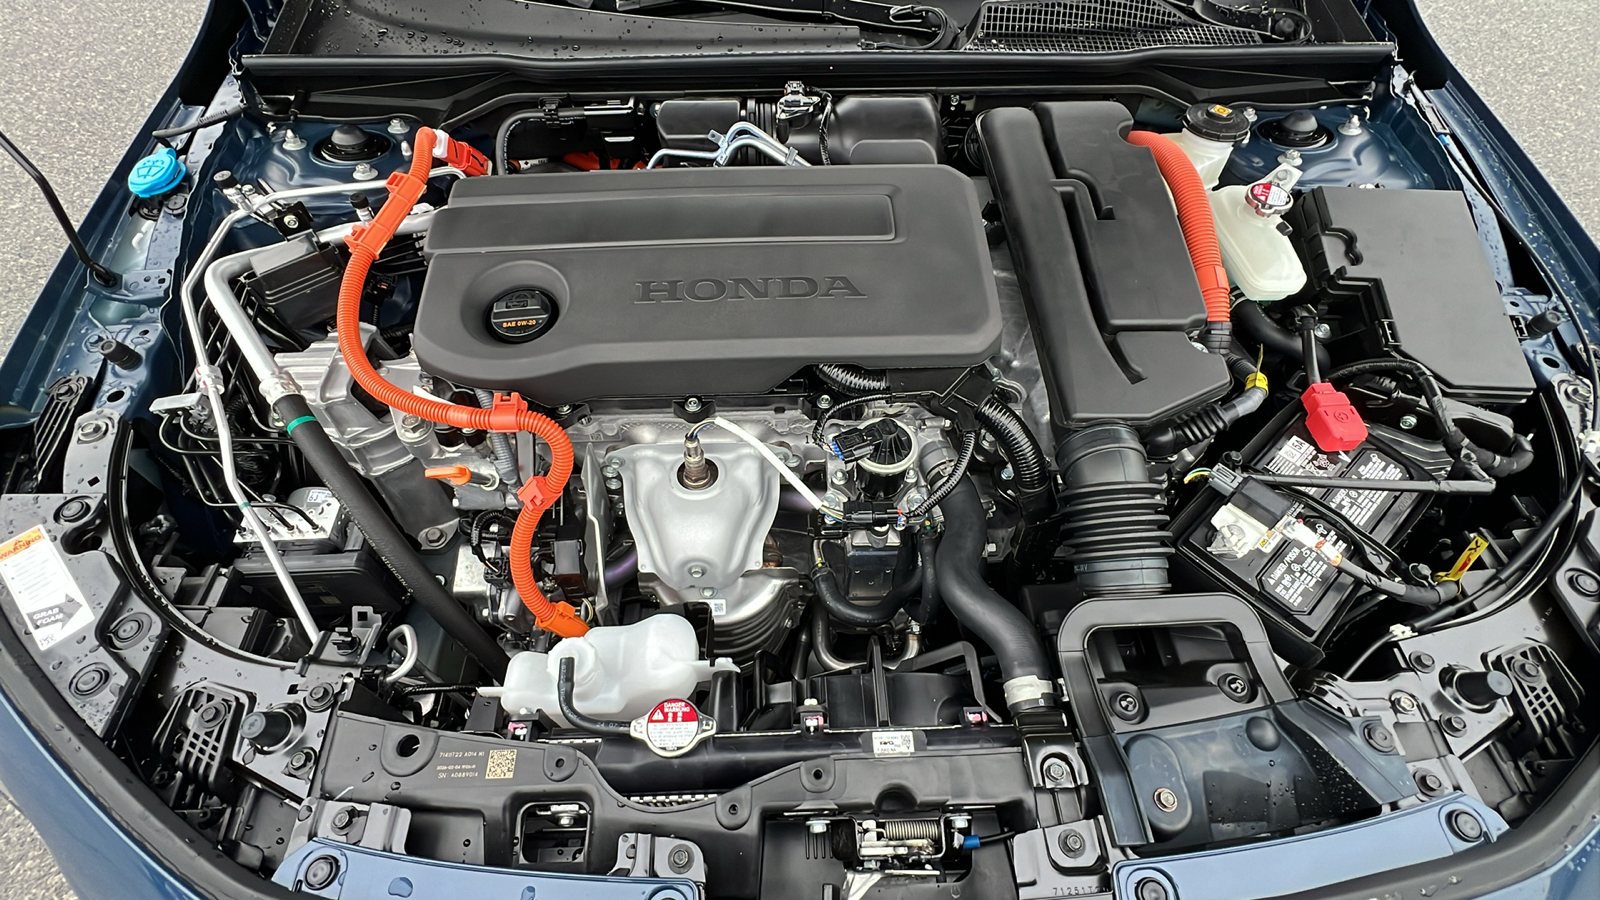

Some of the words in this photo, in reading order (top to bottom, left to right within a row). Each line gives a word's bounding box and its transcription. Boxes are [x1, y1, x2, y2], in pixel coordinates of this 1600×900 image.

[634, 276, 868, 304] HONDA
[517, 319, 537, 327] 0W-20
[1291, 439, 1306, 451] 5A
[0, 533, 41, 560] WARNING
[33, 607, 60, 620] GRAB
[36, 612, 64, 626] FOAM
